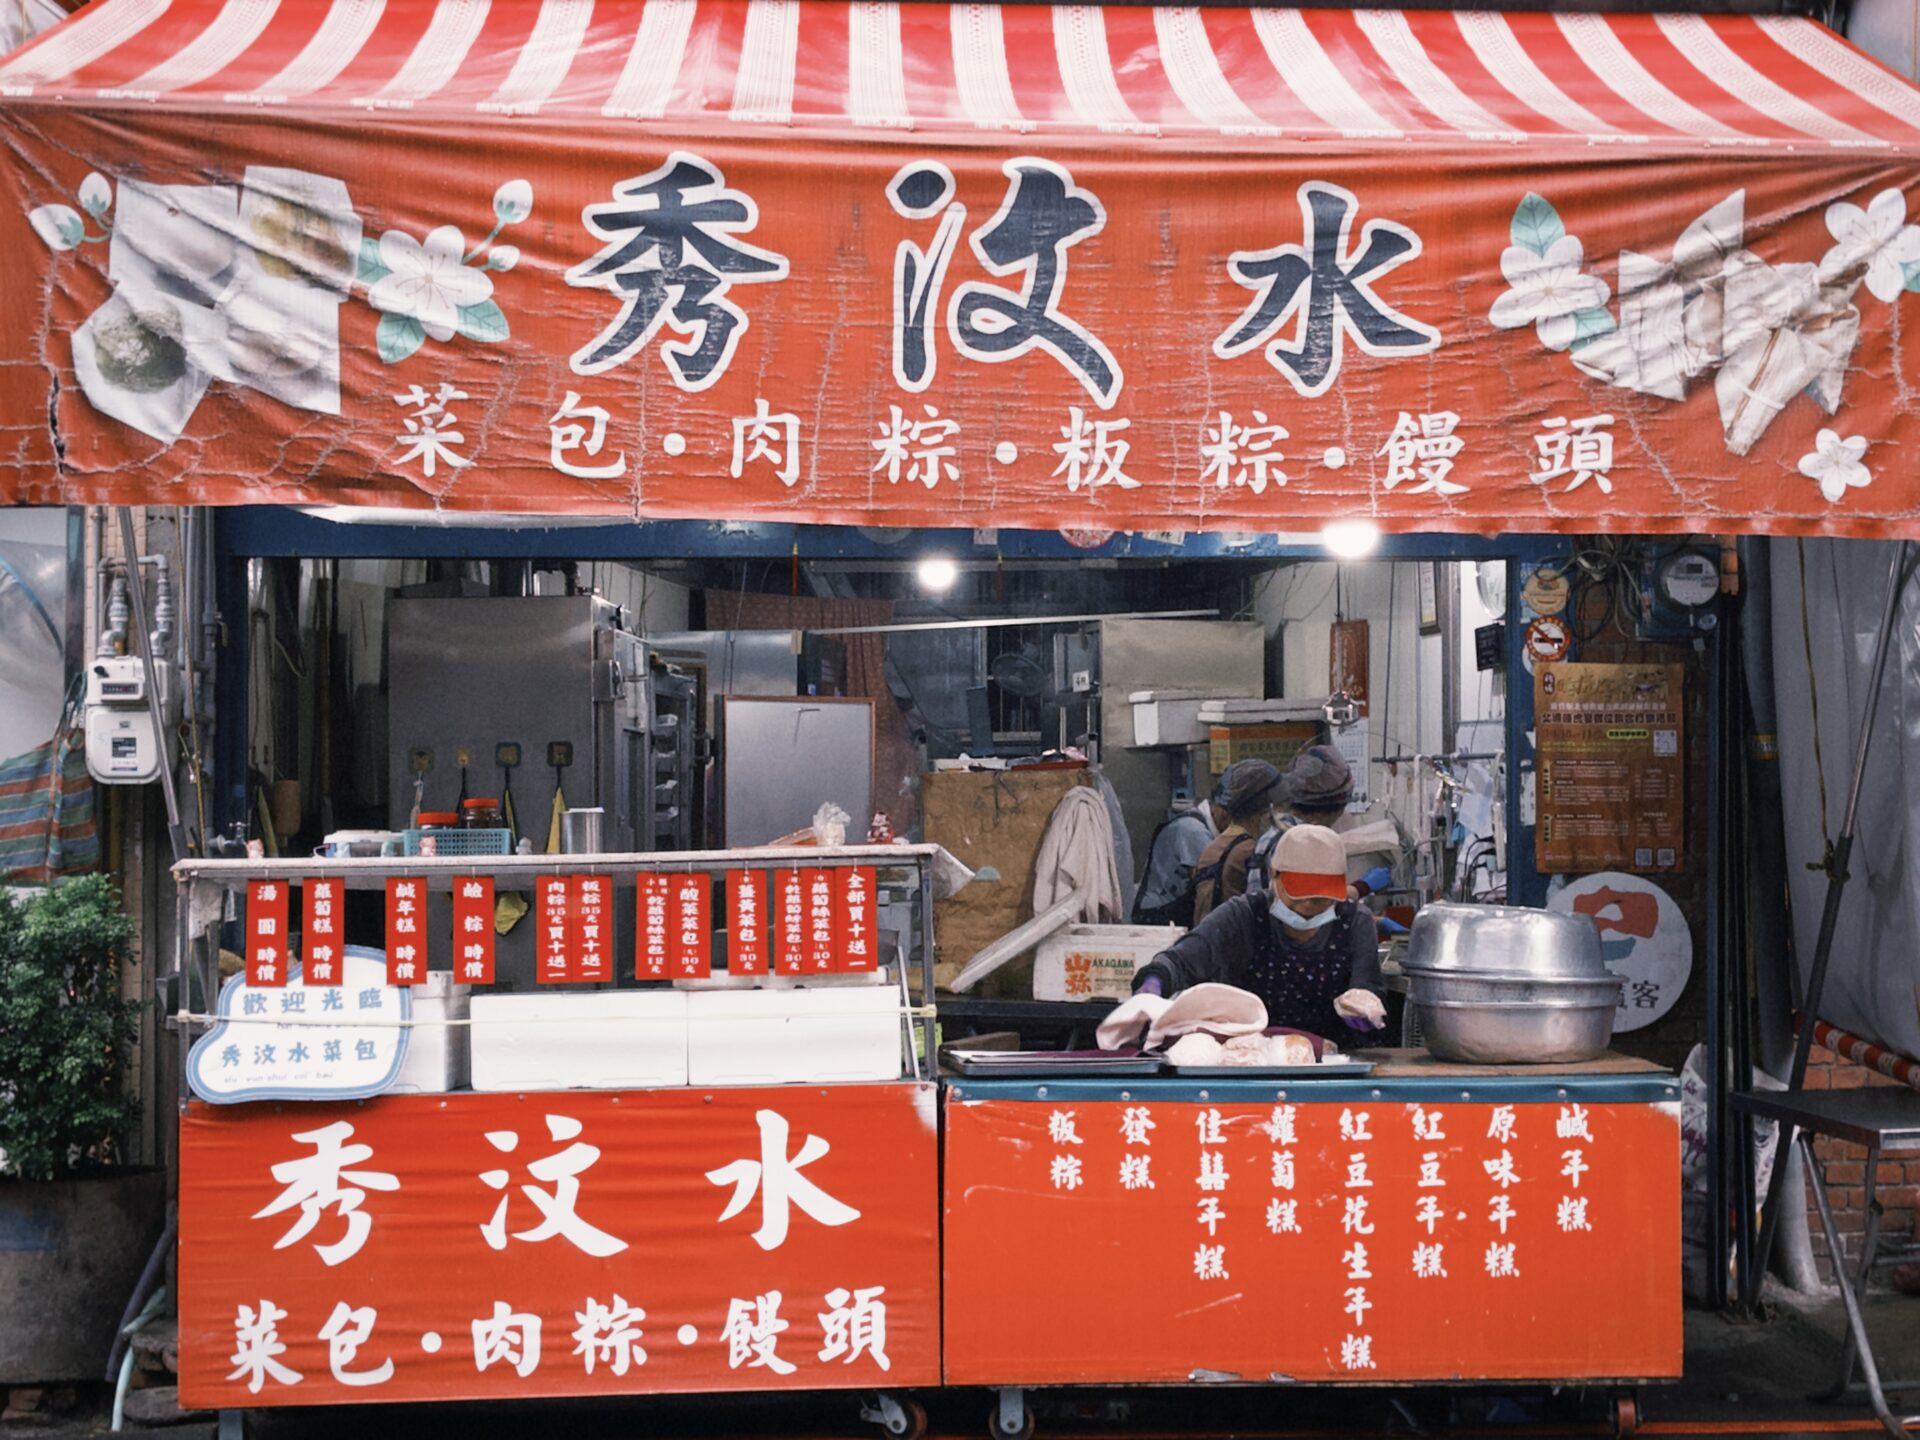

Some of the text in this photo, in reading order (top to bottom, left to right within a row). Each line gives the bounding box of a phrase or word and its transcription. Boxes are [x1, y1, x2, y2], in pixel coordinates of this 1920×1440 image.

[847, 873, 867, 966] 全部買十送一
[222, 1038, 377, 1068] 秀汶水菜包
[243, 987, 382, 1015] 歡迎光臨
[251, 1109, 861, 1267] 秀汶水
[1048, 1109, 1084, 1191] 粄粽
[1119, 1106, 1157, 1190] 發糕
[1193, 1107, 1230, 1281] 佳囍年糕
[1265, 1105, 1302, 1234] 蘿蔔糕
[1411, 1107, 1448, 1278] 紅豆年糕
[1482, 1104, 1521, 1278] 原味年糕
[1555, 1103, 1594, 1232] 鹹年糕
[1338, 1107, 1377, 1370] 紅豆花生年糕
